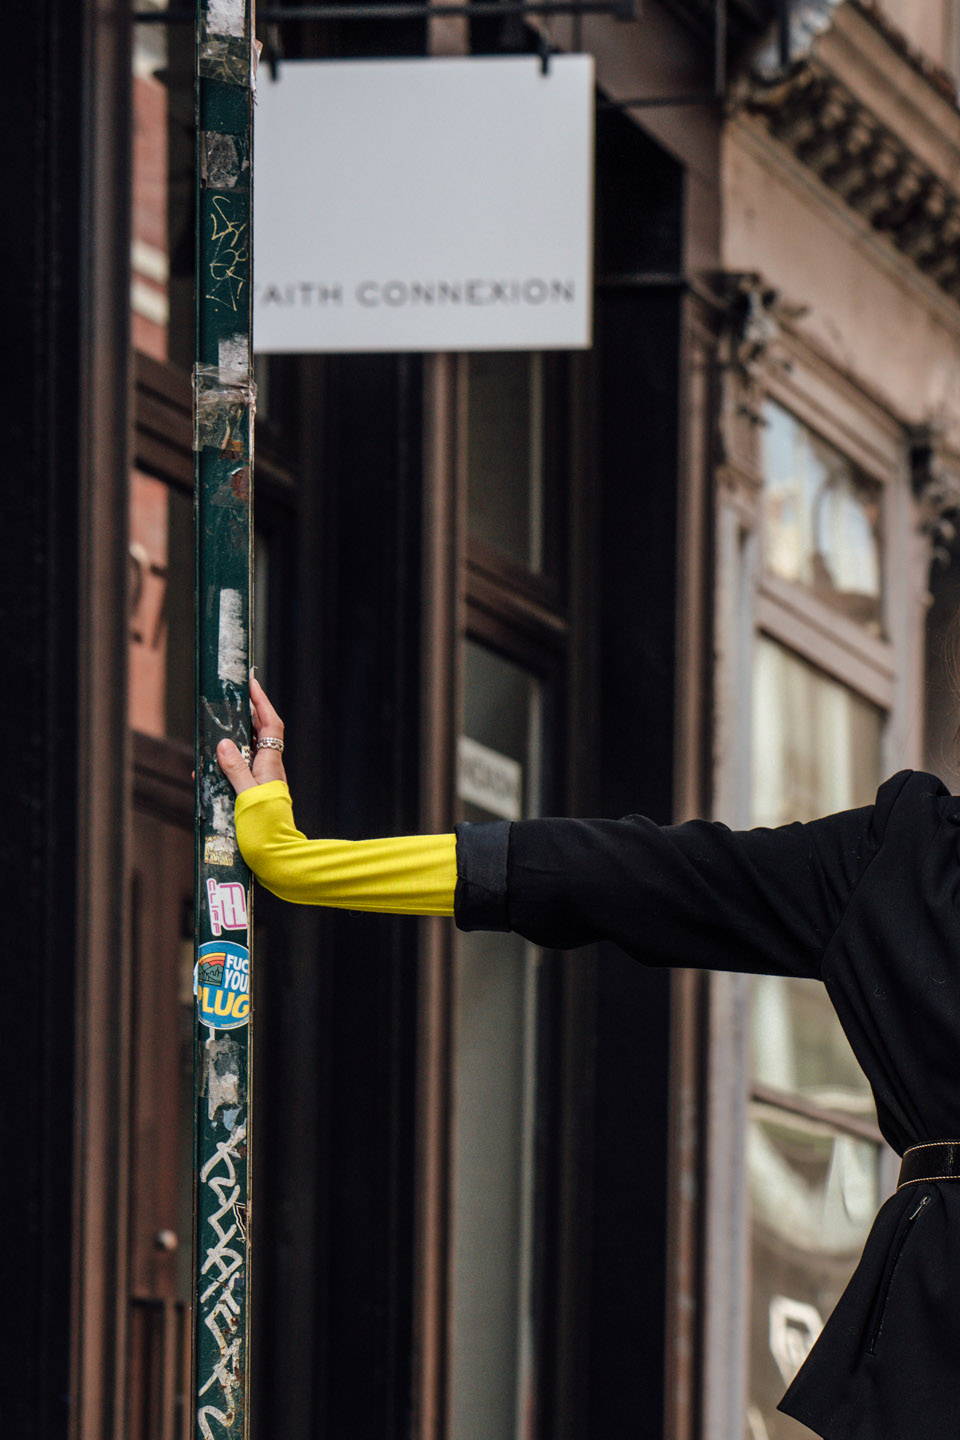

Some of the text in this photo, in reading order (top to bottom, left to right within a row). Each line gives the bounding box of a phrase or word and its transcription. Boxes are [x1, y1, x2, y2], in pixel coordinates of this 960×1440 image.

[255, 278, 576, 308] AITH CONNEXION
[208, 879, 221, 934] CLIFF
[226, 954, 250, 974] FUC
[224, 968, 250, 994] YOU
